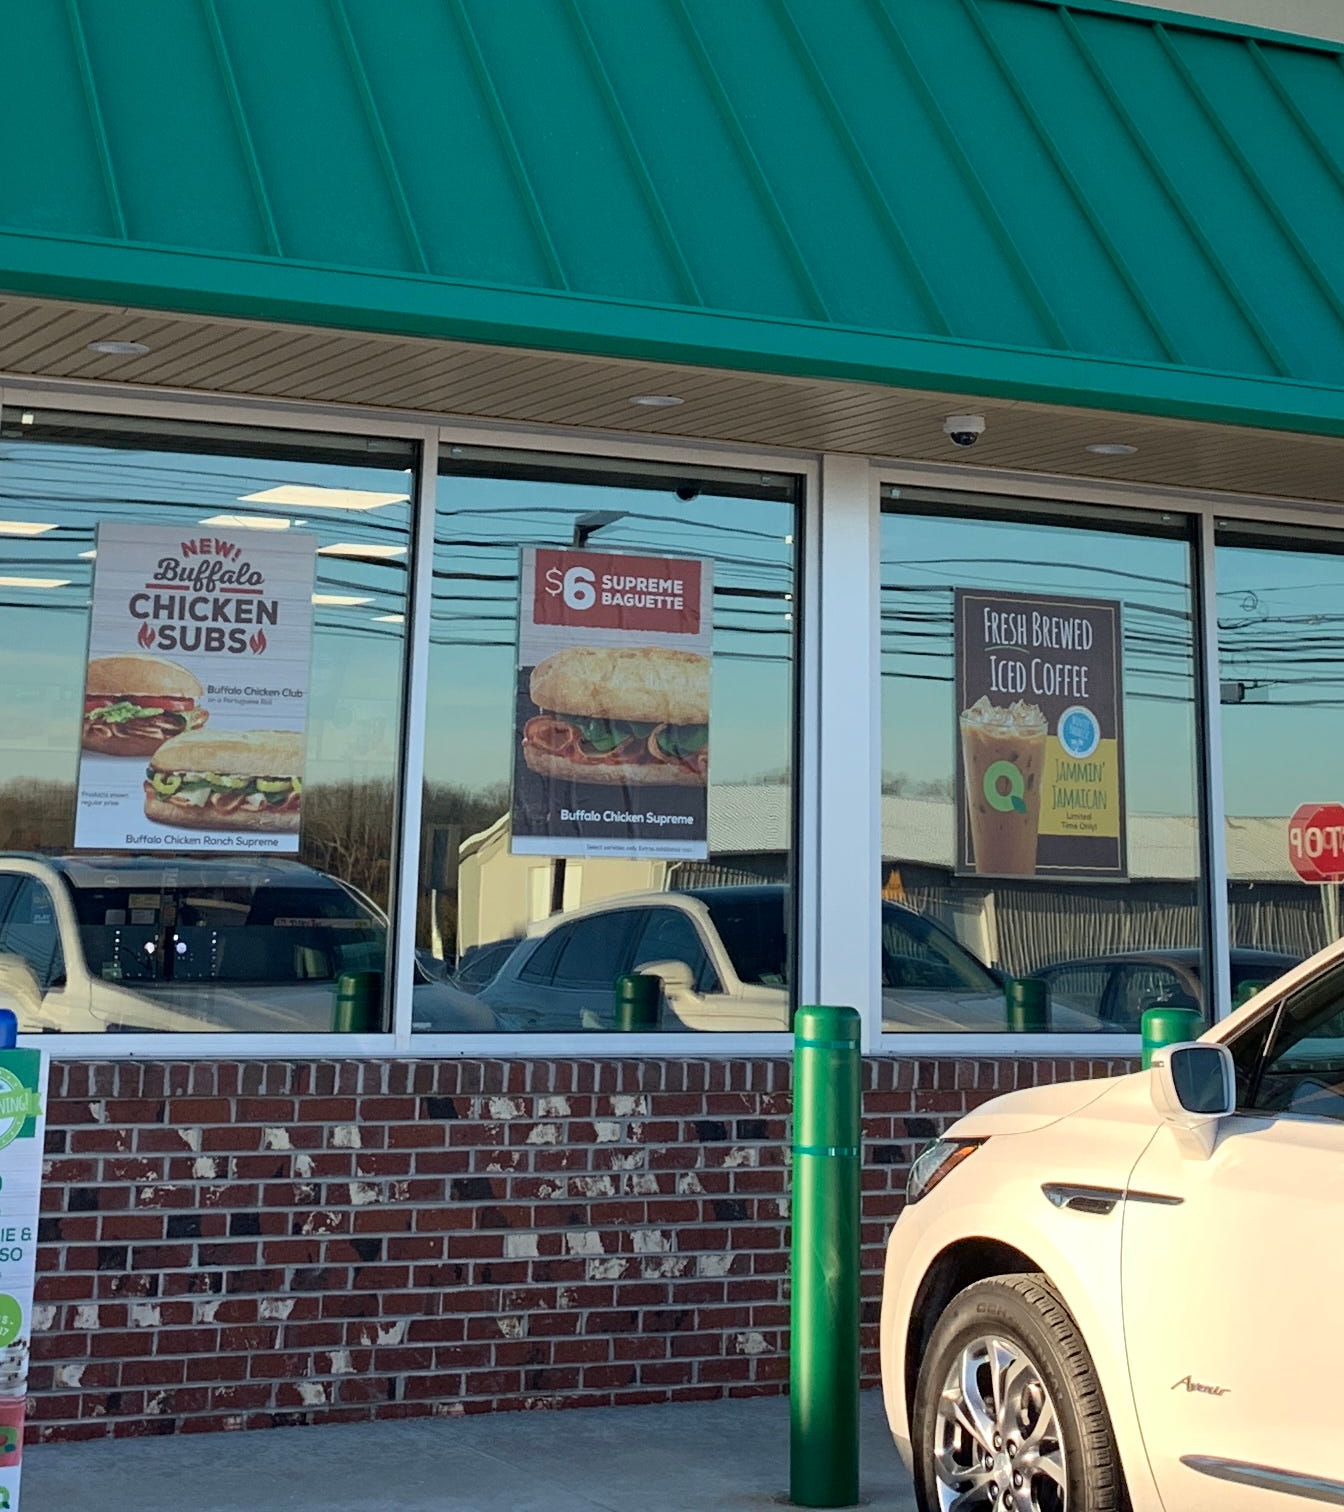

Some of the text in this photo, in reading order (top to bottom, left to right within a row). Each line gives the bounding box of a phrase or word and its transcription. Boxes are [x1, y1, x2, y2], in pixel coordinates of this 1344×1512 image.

[180, 538, 243, 562] NEW!
[153, 557, 265, 593] Buffalo
[545, 567, 684, 611] $6 SUPREME
[602, 592, 684, 610] BAGUETTE
[129, 593, 278, 625] CHICKEN
[158, 627, 247, 654] SUBS
[984, 607, 1093, 651] FRESH BREWED
[990, 655, 1089, 698] ICED COFFEE
[207, 685, 303, 698] Buffalo Chicken Club
[560, 809, 694, 826] Buffalo Chicken Supreme
[1061, 821, 1077, 829] Time
[125, 834, 279, 848] Buffalo Chicken Ranch Supreme
[21, 1227, 31, 1241] &
